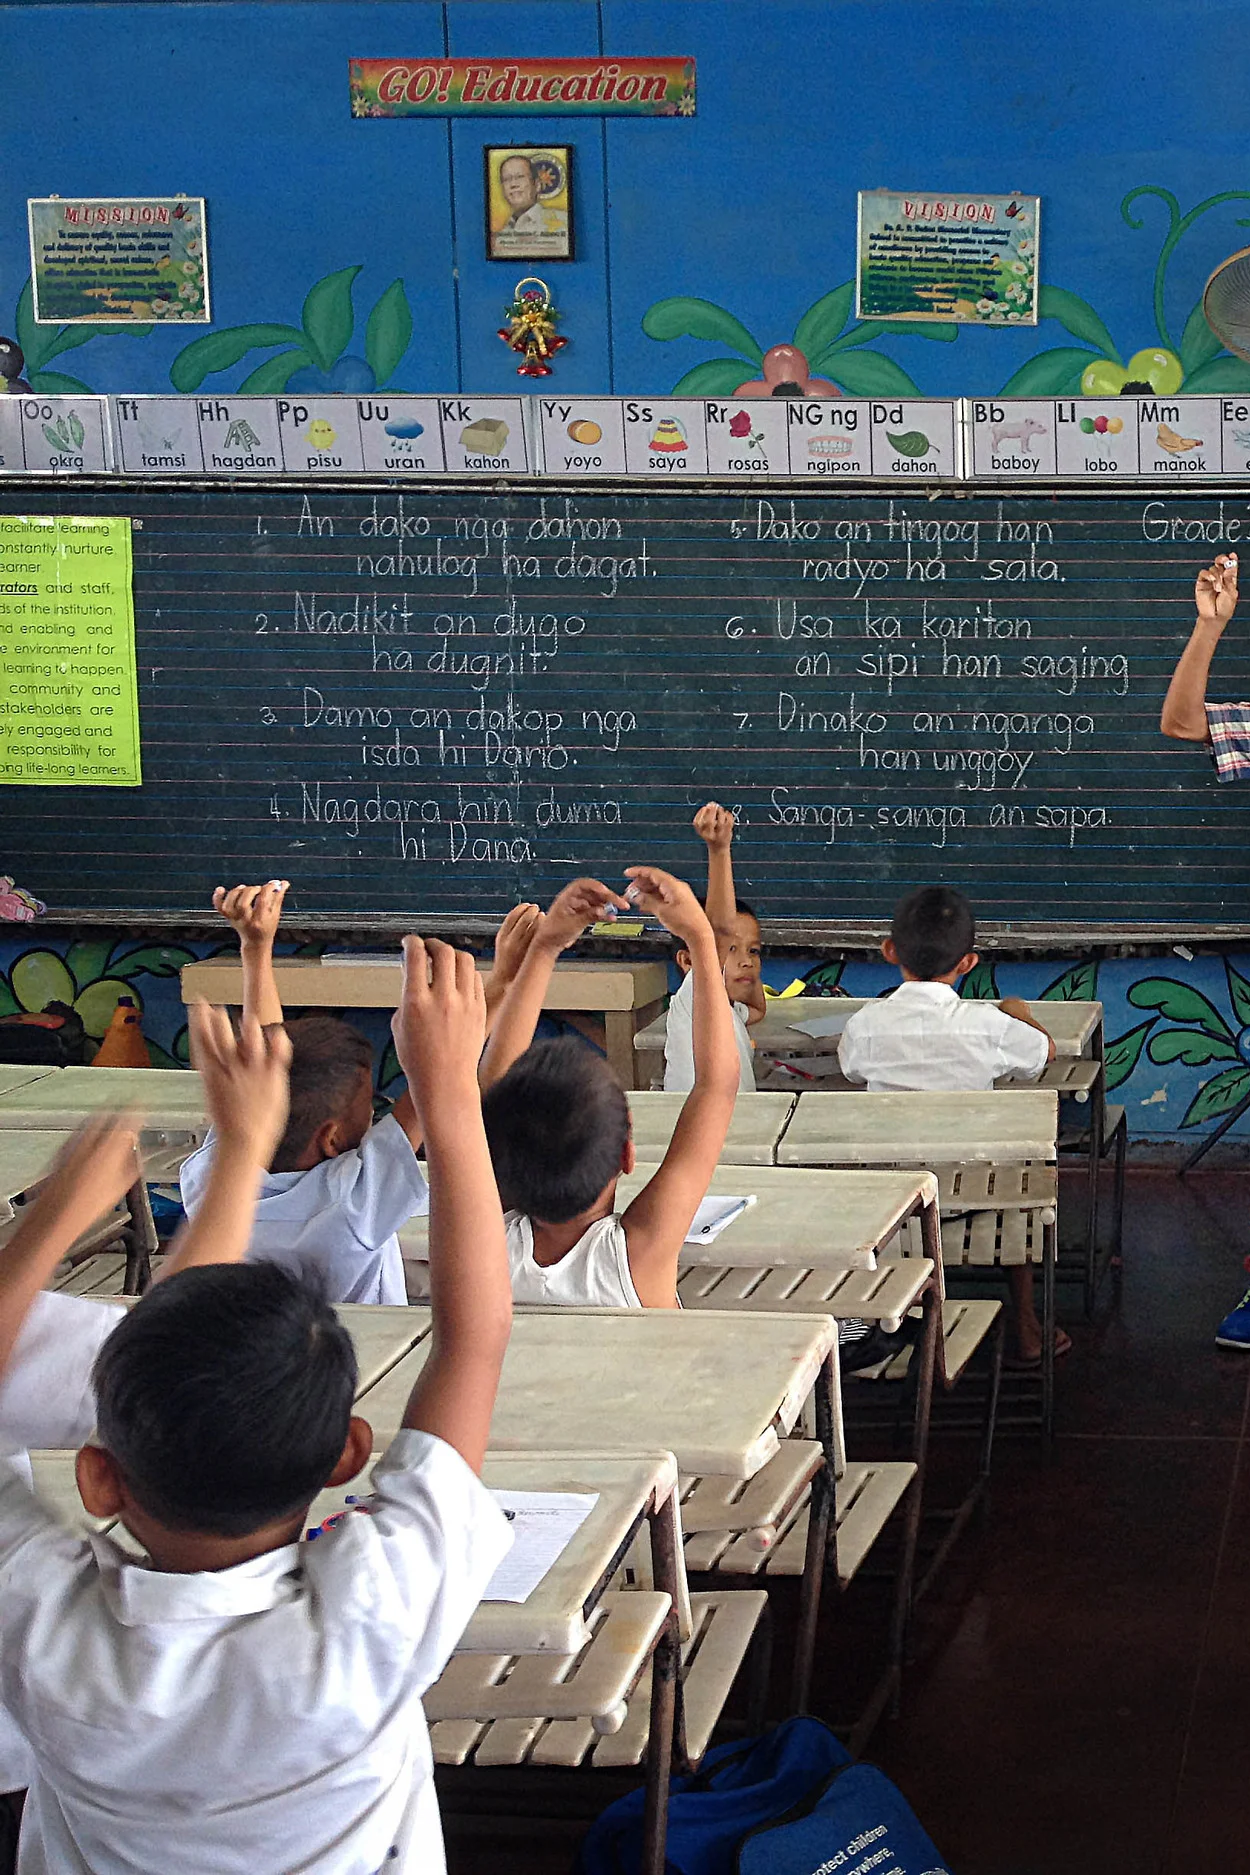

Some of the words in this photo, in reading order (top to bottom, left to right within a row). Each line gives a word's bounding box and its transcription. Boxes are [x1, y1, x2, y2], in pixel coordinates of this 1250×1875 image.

[377, 66, 453, 103] GO!
[460, 64, 669, 103] Education
[64, 205, 171, 225] MISSION
[904, 200, 996, 223] VISION
[24, 401, 53, 420] Oo
[119, 401, 139, 421] Tt
[200, 401, 229, 421] Hh
[279, 403, 309, 426] Pp
[359, 402, 389, 421] Uu
[442, 402, 472, 421] Kk
[543, 401, 572, 422] Yy
[627, 403, 653, 422] Ss
[707, 403, 728, 422] Rr
[789, 404, 823, 425] NG
[832, 408, 858, 430] ng
[873, 405, 903, 424] Dd
[975, 403, 1004, 422] Bb
[1058, 403, 1075, 422] Ll
[1141, 402, 1180, 421] Mm
[1224, 402, 1248, 421] Ee
[142, 453, 185, 467] tamsi
[212, 453, 276, 470] hagdan
[307, 454, 342, 469] pisu
[385, 457, 425, 469] uran
[464, 455, 510, 469] kahon
[564, 456, 602, 470] yoyo
[649, 457, 687, 472] saya
[728, 458, 769, 471] rosas
[808, 460, 860, 473] ngipon
[892, 460, 937, 473] dahon
[992, 455, 1040, 473] baboy
[1085, 457, 1117, 471] lobo
[1154, 457, 1206, 471] manok
[0, 523, 55, 534] facilitate
[299, 495, 334, 538] An
[359, 495, 430, 538] dako
[455, 515, 508, 558] nga
[528, 498, 622, 541] dahon
[757, 499, 821, 542] Dako
[834, 519, 871, 542] an
[884, 500, 979, 561] tingog
[998, 501, 1054, 544] han
[1142, 501, 1241, 543] Grade
[357, 539, 479, 598] nahulog
[503, 539, 540, 577] ha
[803, 542, 889, 599] radyo
[907, 543, 946, 581] ha
[981, 542, 1066, 582] sala.
[45, 582, 72, 594] and
[14, 604, 26, 614] of
[30, 604, 50, 614] the
[255, 612, 279, 635] 2.
[295, 591, 413, 634] Nadikit
[434, 613, 477, 636] an
[493, 595, 585, 657] dugo
[725, 616, 756, 639] 6.
[777, 598, 833, 640] Usa
[865, 599, 901, 639] ka
[922, 598, 1031, 640] kariton
[20, 624, 75, 637] enabling
[87, 625, 113, 635] and
[14, 643, 92, 655] environment
[96, 643, 116, 655] for
[373, 634, 413, 672] ha
[3, 663, 51, 676] learning
[56, 664, 67, 674] to
[795, 651, 831, 676] an
[855, 641, 918, 697] sipi
[943, 638, 1001, 677] han
[1019, 645, 1129, 696] saging
[9, 684, 83, 697] community
[91, 684, 121, 696] and
[0, 702, 82, 715] stakeholders
[90, 706, 114, 716] are
[303, 687, 391, 728] Damo
[409, 707, 451, 729] an
[466, 693, 562, 747] dakop
[583, 709, 637, 750] nga
[17, 725, 81, 738] engaged
[84, 725, 113, 737] and
[733, 712, 753, 730] 7.
[778, 691, 887, 734] Dinako
[913, 711, 954, 734] an
[973, 711, 1095, 755] nganga
[7, 744, 91, 758] responsibility
[98, 745, 117, 757] for
[362, 728, 419, 766] isda
[439, 729, 466, 766] hi
[486, 731, 577, 770] Dario.
[26, 762, 75, 776] life-long
[860, 731, 920, 771] han
[932, 750, 1034, 791] unggoy
[269, 793, 290, 822] 4.
[302, 782, 441, 837] Nagdara
[459, 784, 512, 823] hin
[536, 785, 622, 828] duma
[989, 804, 1024, 826] an
[400, 821, 427, 861] hi
[847, 1825, 888, 1856] children
